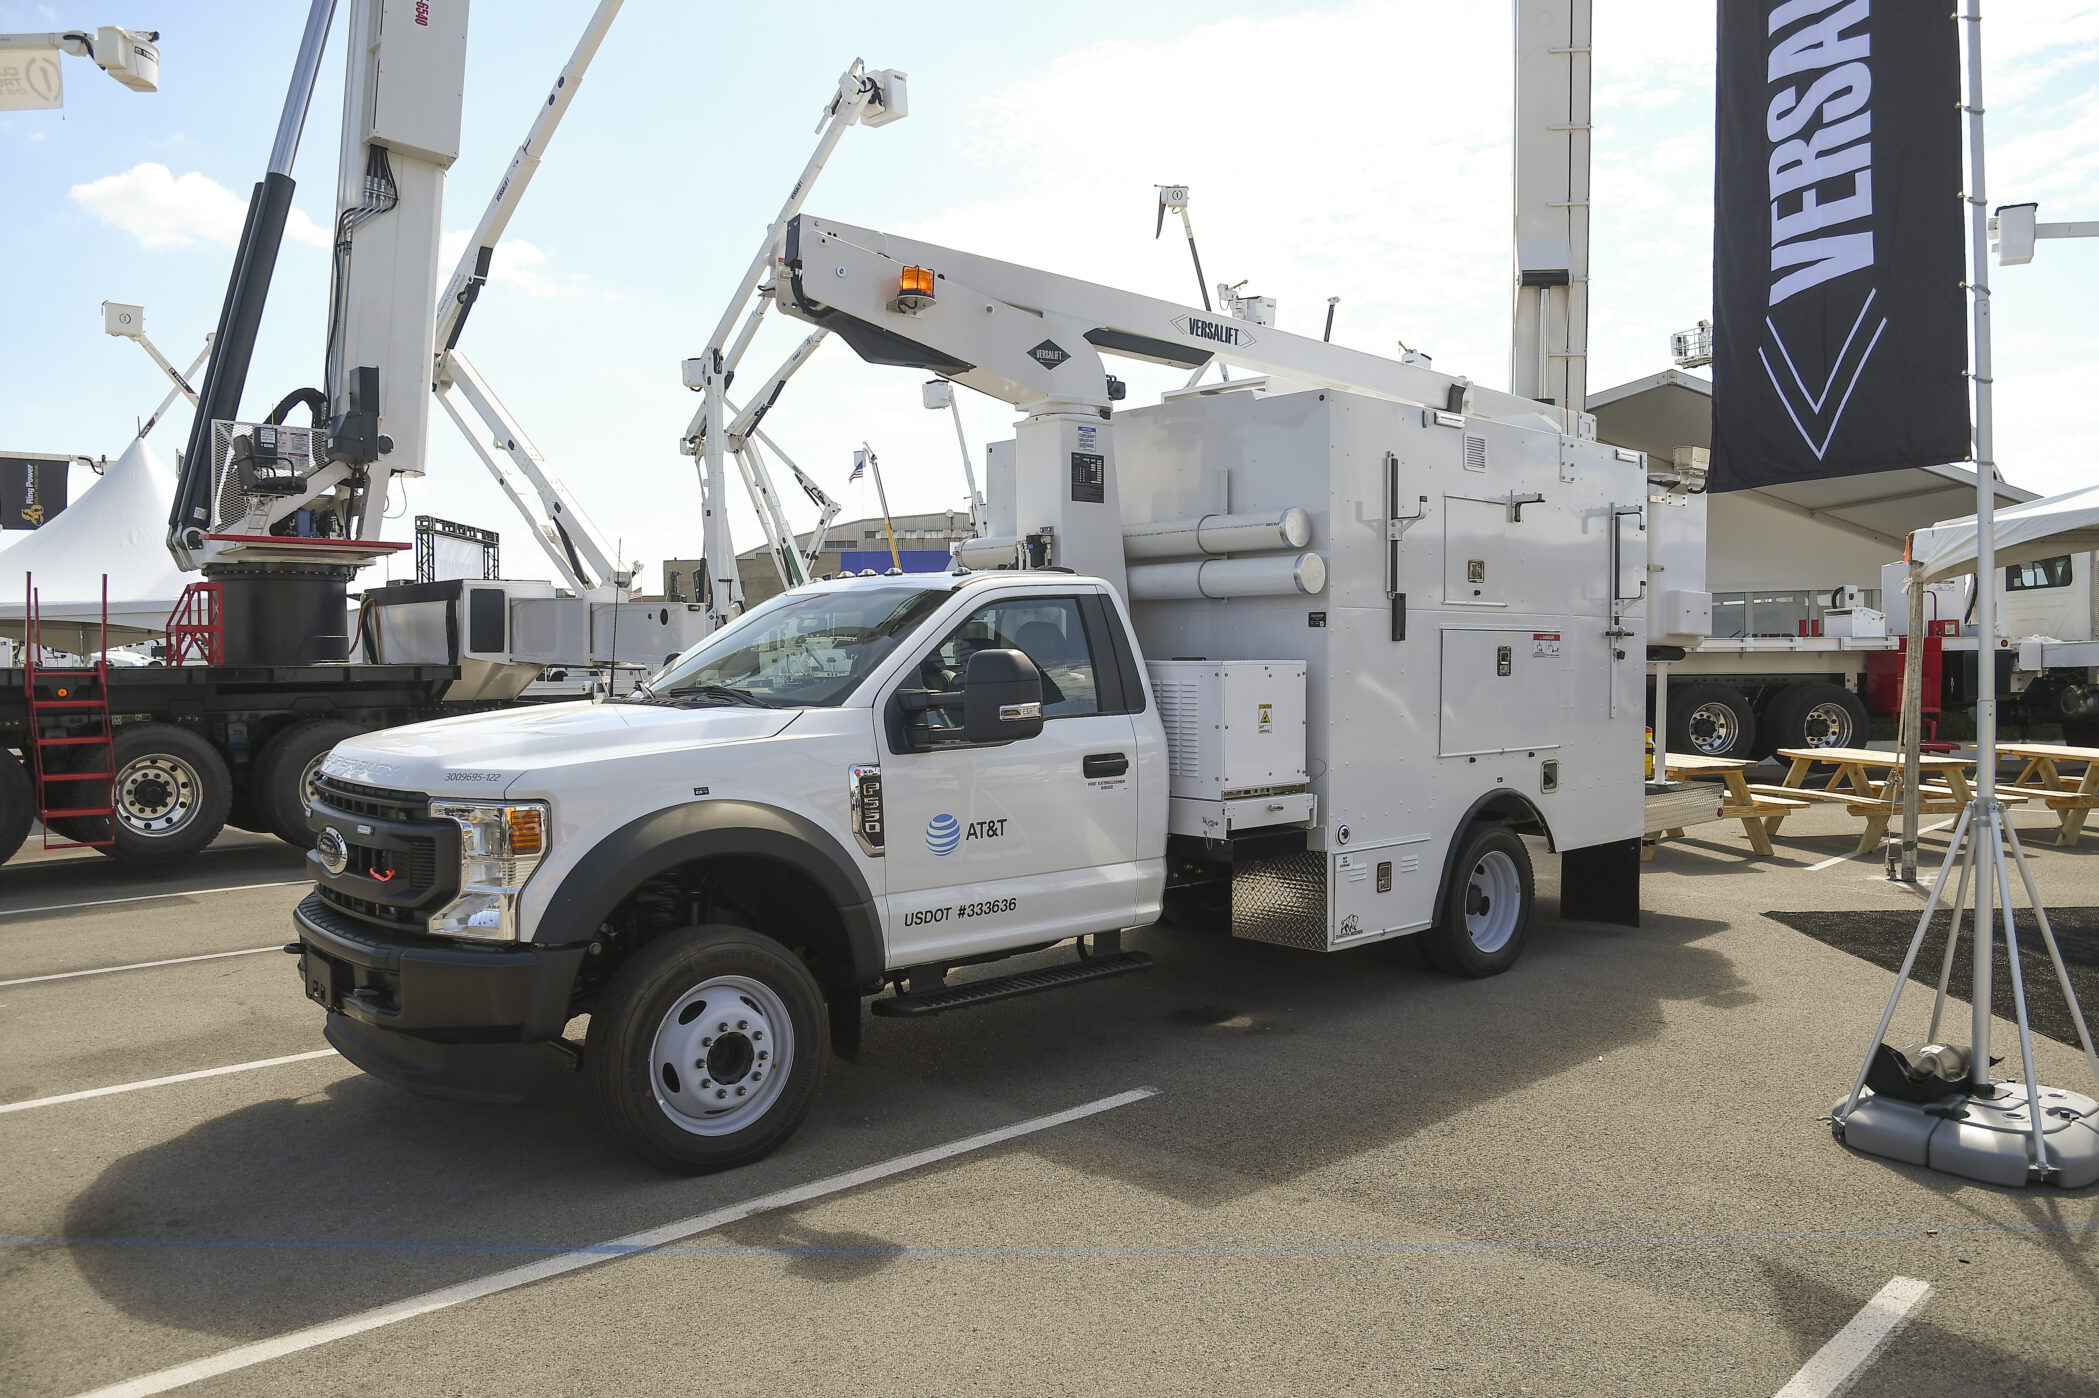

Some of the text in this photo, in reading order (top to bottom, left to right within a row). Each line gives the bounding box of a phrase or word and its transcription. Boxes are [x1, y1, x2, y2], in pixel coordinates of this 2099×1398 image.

[1188, 317, 1239, 346] VERSALIFT
[1035, 349, 1062, 360] VERSALIFT
[25, 464, 35, 504] Ring Power
[445, 772, 501, 782] 3009695-122
[965, 818, 1008, 841] AT&T
[904, 897, 1017, 927] USDOT #333636
